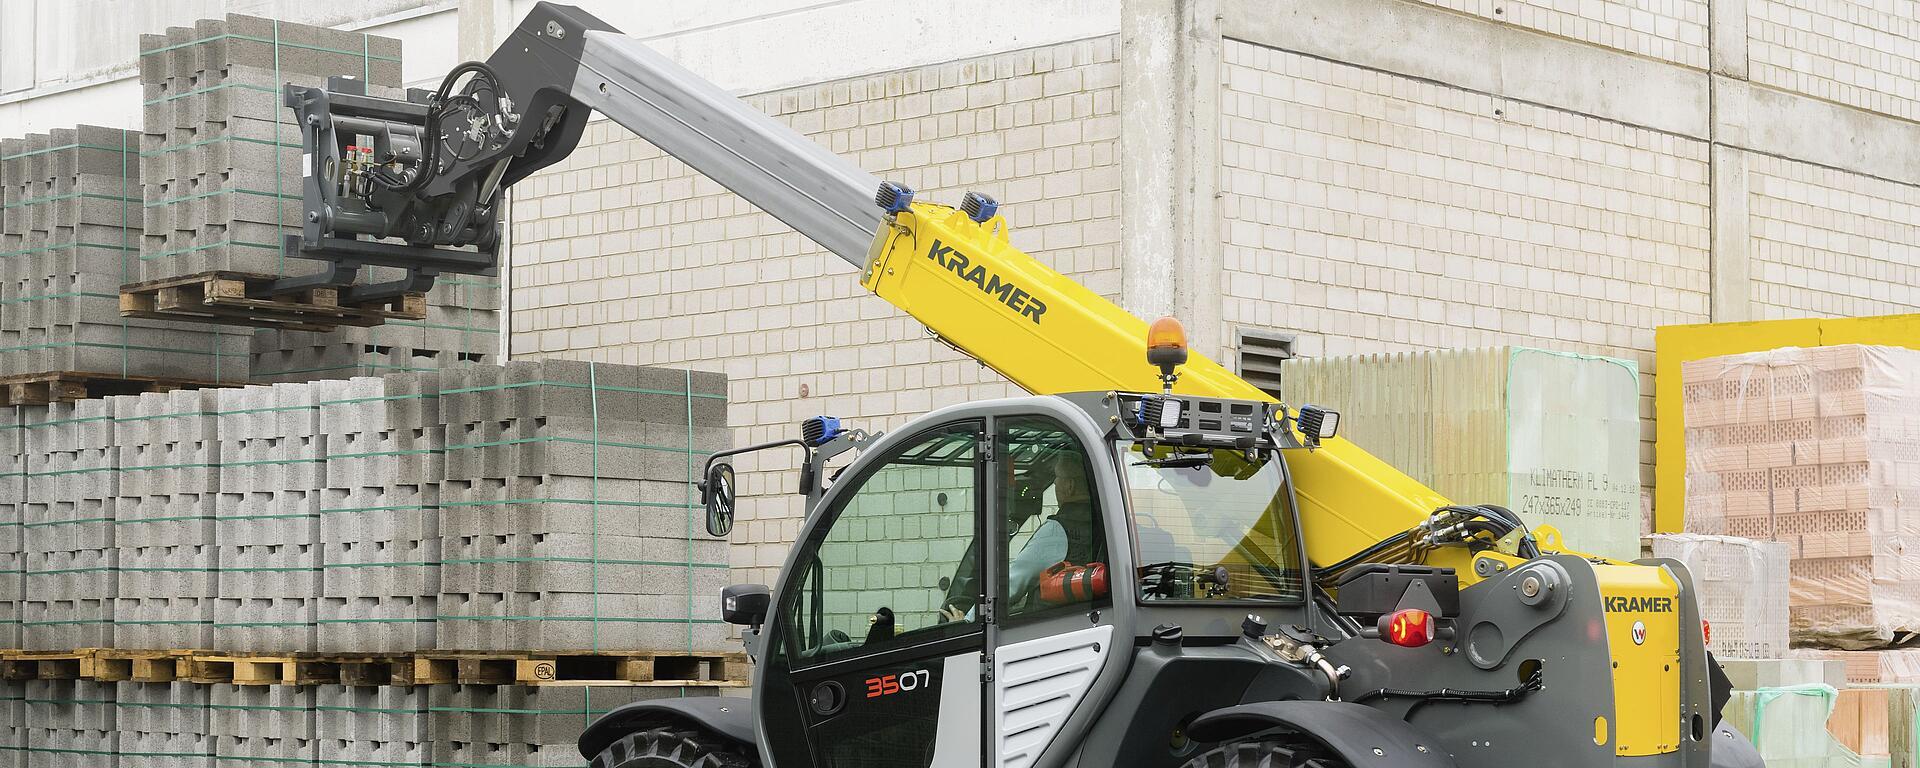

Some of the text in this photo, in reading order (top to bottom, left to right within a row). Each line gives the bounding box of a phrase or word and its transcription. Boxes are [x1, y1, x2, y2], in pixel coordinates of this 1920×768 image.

[927, 239, 1047, 325] KRAMER
[1530, 468, 1583, 490] KLIMATHERM
[1587, 472, 1598, 491] PL
[1522, 494, 1582, 517] 247x365x249
[1604, 596, 1672, 613] KRAMER
[537, 666, 552, 676] EPAL
[865, 669, 930, 698] 3507
